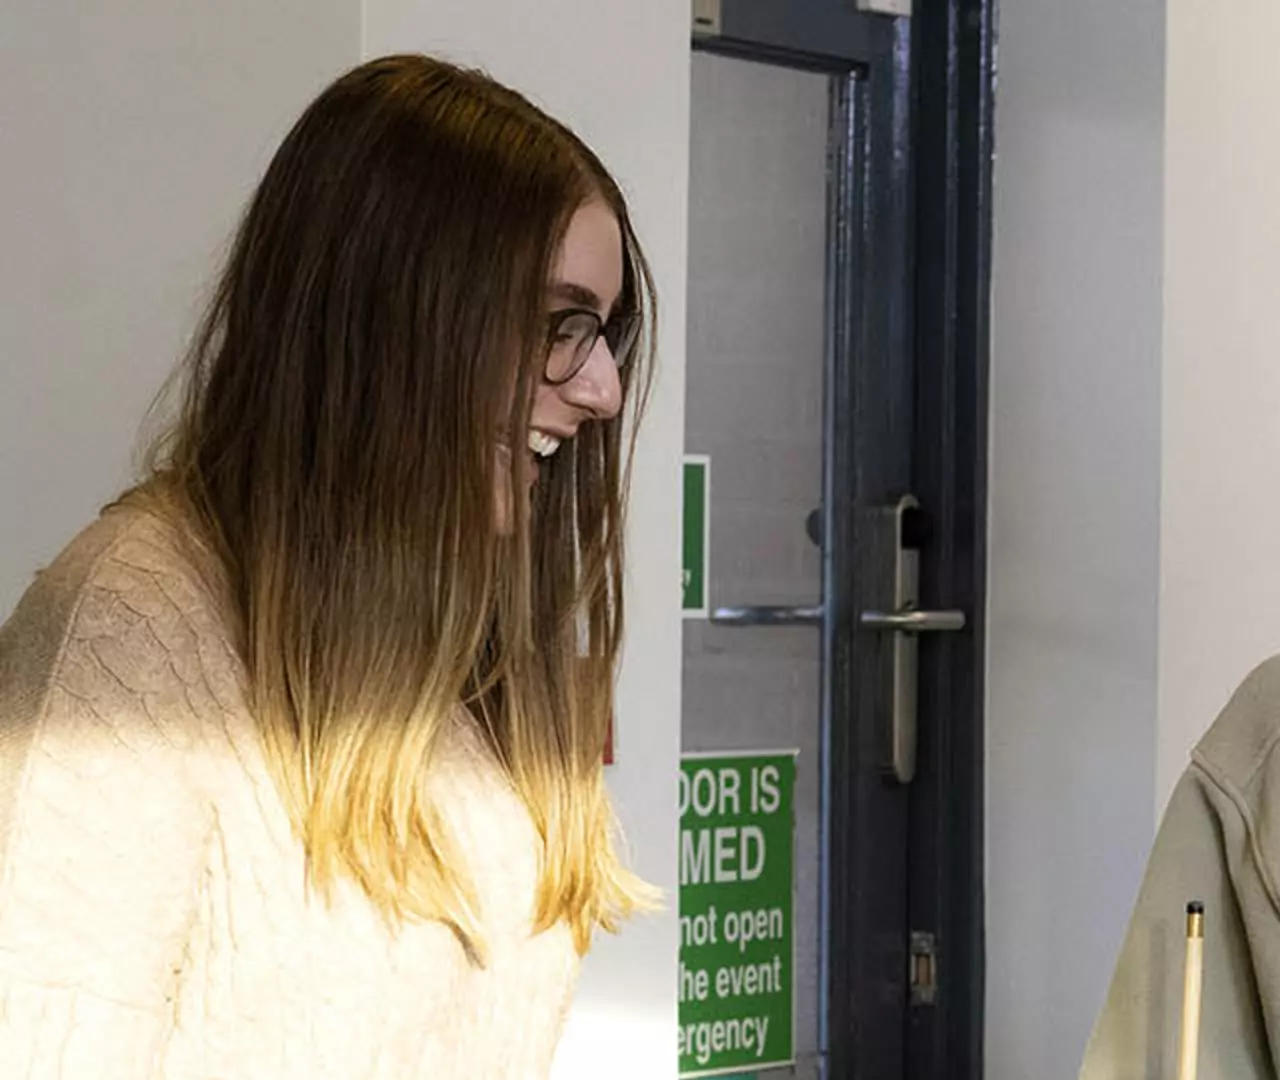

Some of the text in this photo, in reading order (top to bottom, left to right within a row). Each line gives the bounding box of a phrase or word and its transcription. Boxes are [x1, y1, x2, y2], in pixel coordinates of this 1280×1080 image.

[751, 765, 781, 814] IS
[682, 825, 766, 886] MED
[679, 905, 783, 952] not open
[716, 954, 782, 998] event
